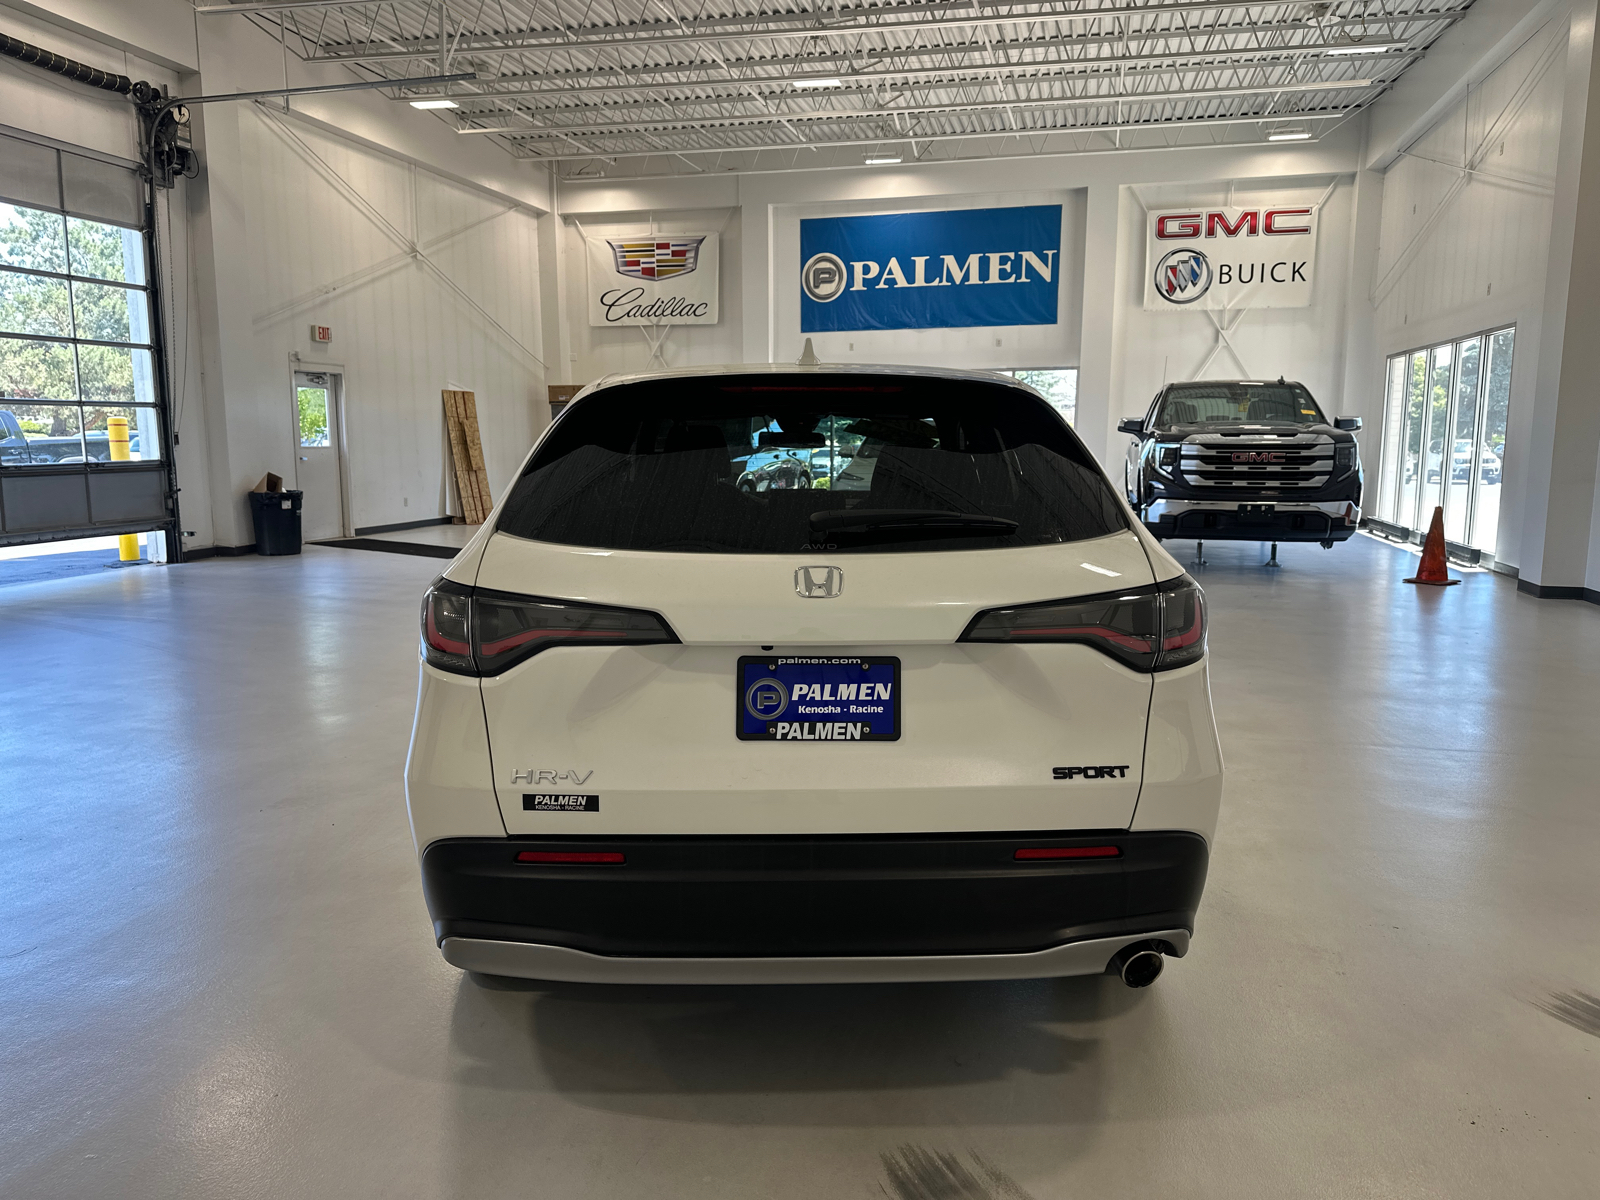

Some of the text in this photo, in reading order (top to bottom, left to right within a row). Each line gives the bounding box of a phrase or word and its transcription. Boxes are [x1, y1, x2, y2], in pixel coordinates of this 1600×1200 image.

[1155, 207, 1312, 240] GMC
[850, 250, 1058, 291] PALMEN
[1219, 261, 1307, 284] BUICK
[600, 287, 708, 322] Cadillac
[318, 326, 330, 341] EXIT
[1232, 452, 1286, 462] GMC
[778, 657, 861, 665] palmen.com
[791, 683, 892, 701] PALMEN
[798, 705, 841, 713] Kenosha
[850, 705, 884, 713] Racine
[776, 722, 862, 740] PALMEN
[510, 768, 594, 785] HR-V
[1052, 765, 1130, 779] SPORT
[534, 795, 587, 805] PALMEN
